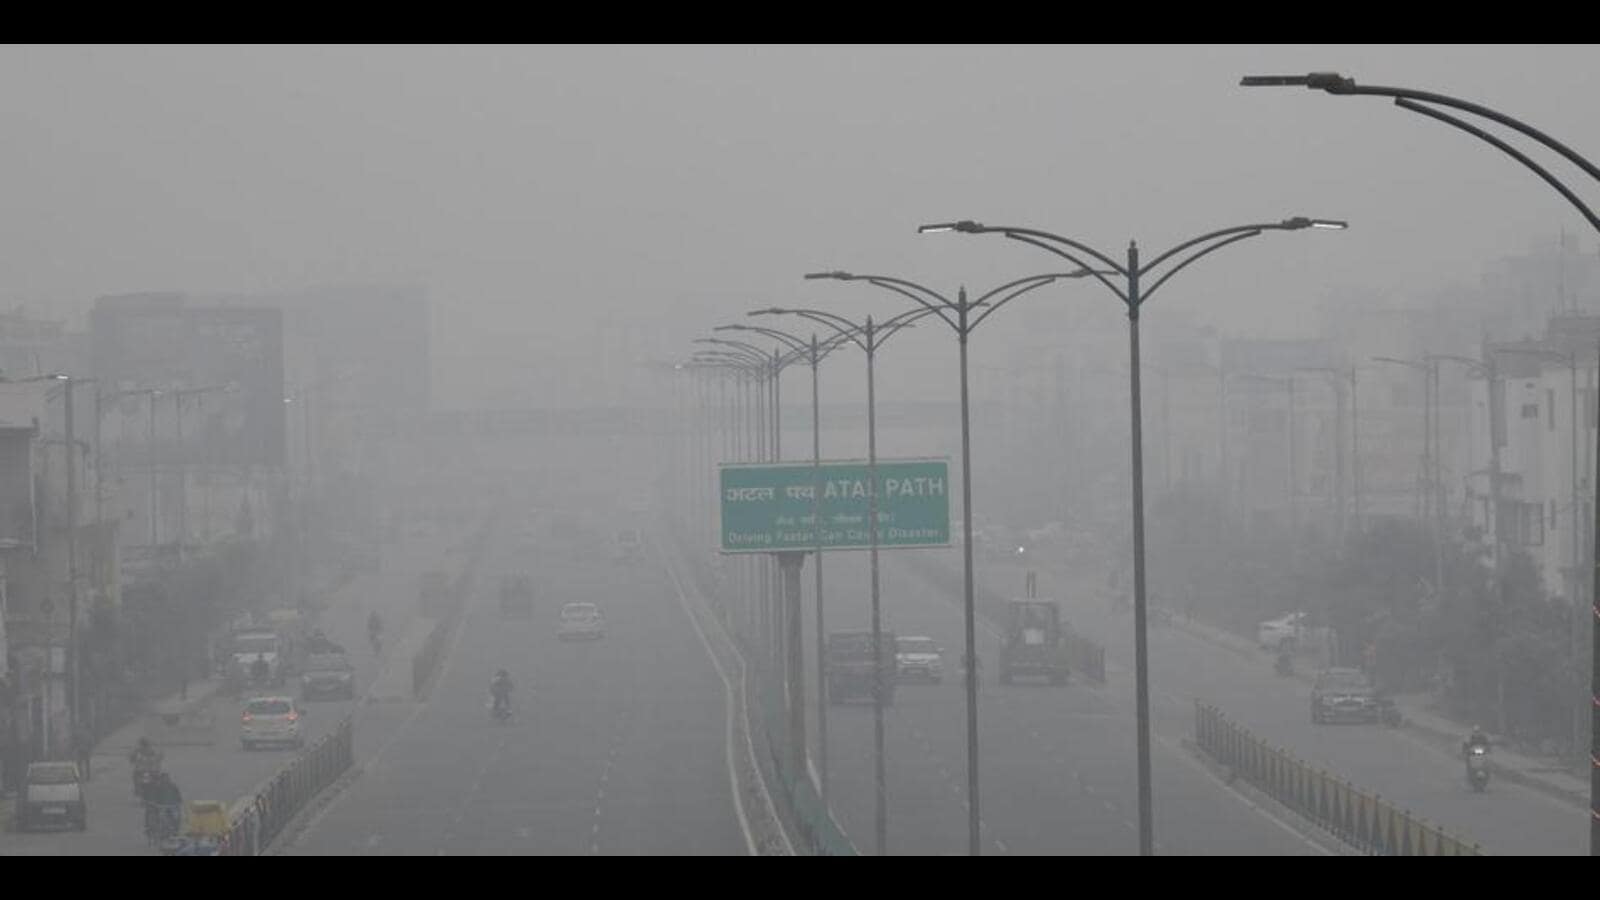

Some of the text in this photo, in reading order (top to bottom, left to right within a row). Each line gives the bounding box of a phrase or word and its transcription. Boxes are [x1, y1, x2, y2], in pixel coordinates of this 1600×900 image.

[726, 487, 775, 502] अटल
[885, 477, 944, 497] PATH
[728, 530, 772, 545] Driving
